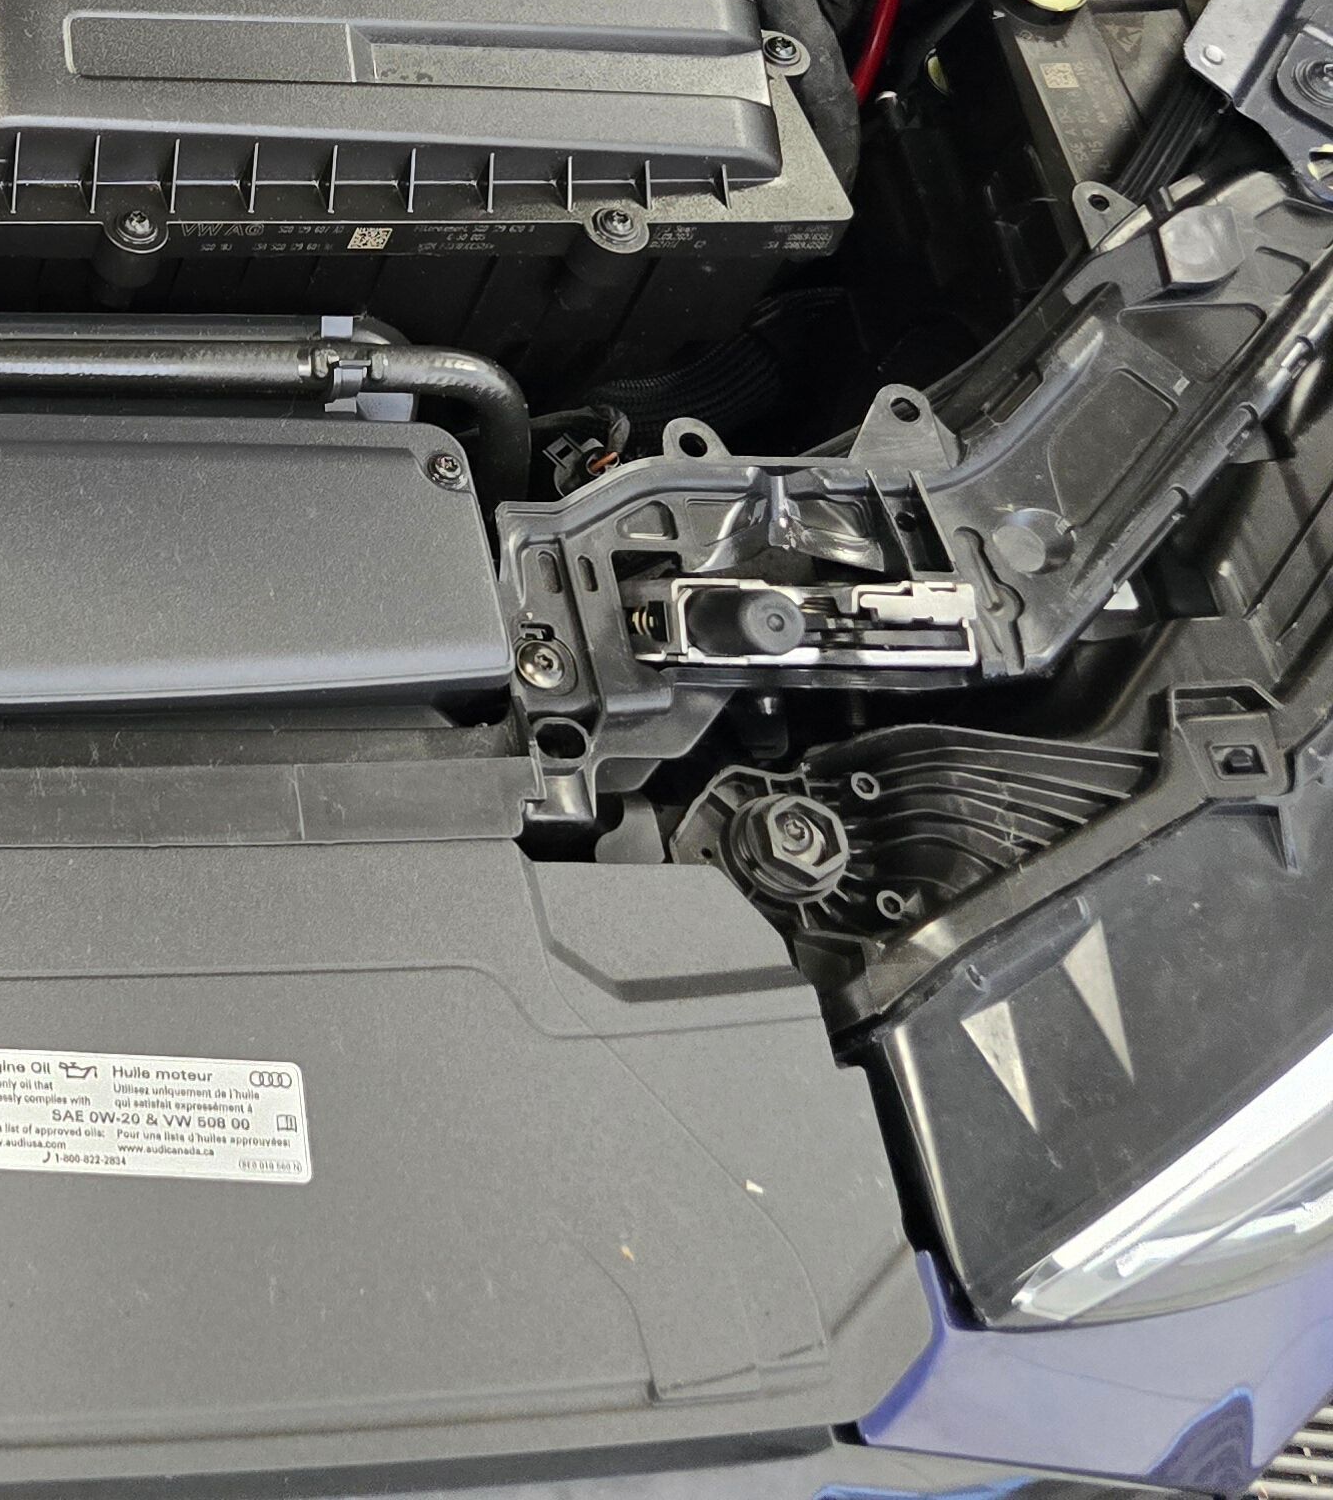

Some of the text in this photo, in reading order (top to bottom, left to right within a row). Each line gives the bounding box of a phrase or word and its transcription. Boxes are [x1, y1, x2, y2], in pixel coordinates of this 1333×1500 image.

[181, 222, 264, 236] VW AG
[30, 1061, 51, 1075] Oil
[112, 1065, 213, 1082] Huile moteur
[20, 1079, 32, 1089] oil
[34, 1080, 53, 1090] that
[113, 1083, 149, 1095] Utilisez
[152, 1086, 212, 1099] uniquement
[214, 1088, 227, 1098] de
[24, 1094, 67, 1106] complies
[70, 1095, 90, 1106] with
[114, 1098, 131, 1110] qui
[133, 1099, 172, 1110] satisfait
[52, 1109, 84, 1123] SAE
[89, 1111, 140, 1125] 0W-20
[146, 1113, 158, 1125] &
[163, 1114, 192, 1128] VW
[197, 1116, 226, 1129] 508
[5, 1122, 19, 1133] list
[22, 1124, 32, 1134] of
[34, 1125, 82, 1138] approved
[117, 1128, 140, 1139] Pour
[143, 1131, 162, 1141] une
[164, 1131, 185, 1142] liste
[117, 1143, 215, 1156] www.audicanada.ca
